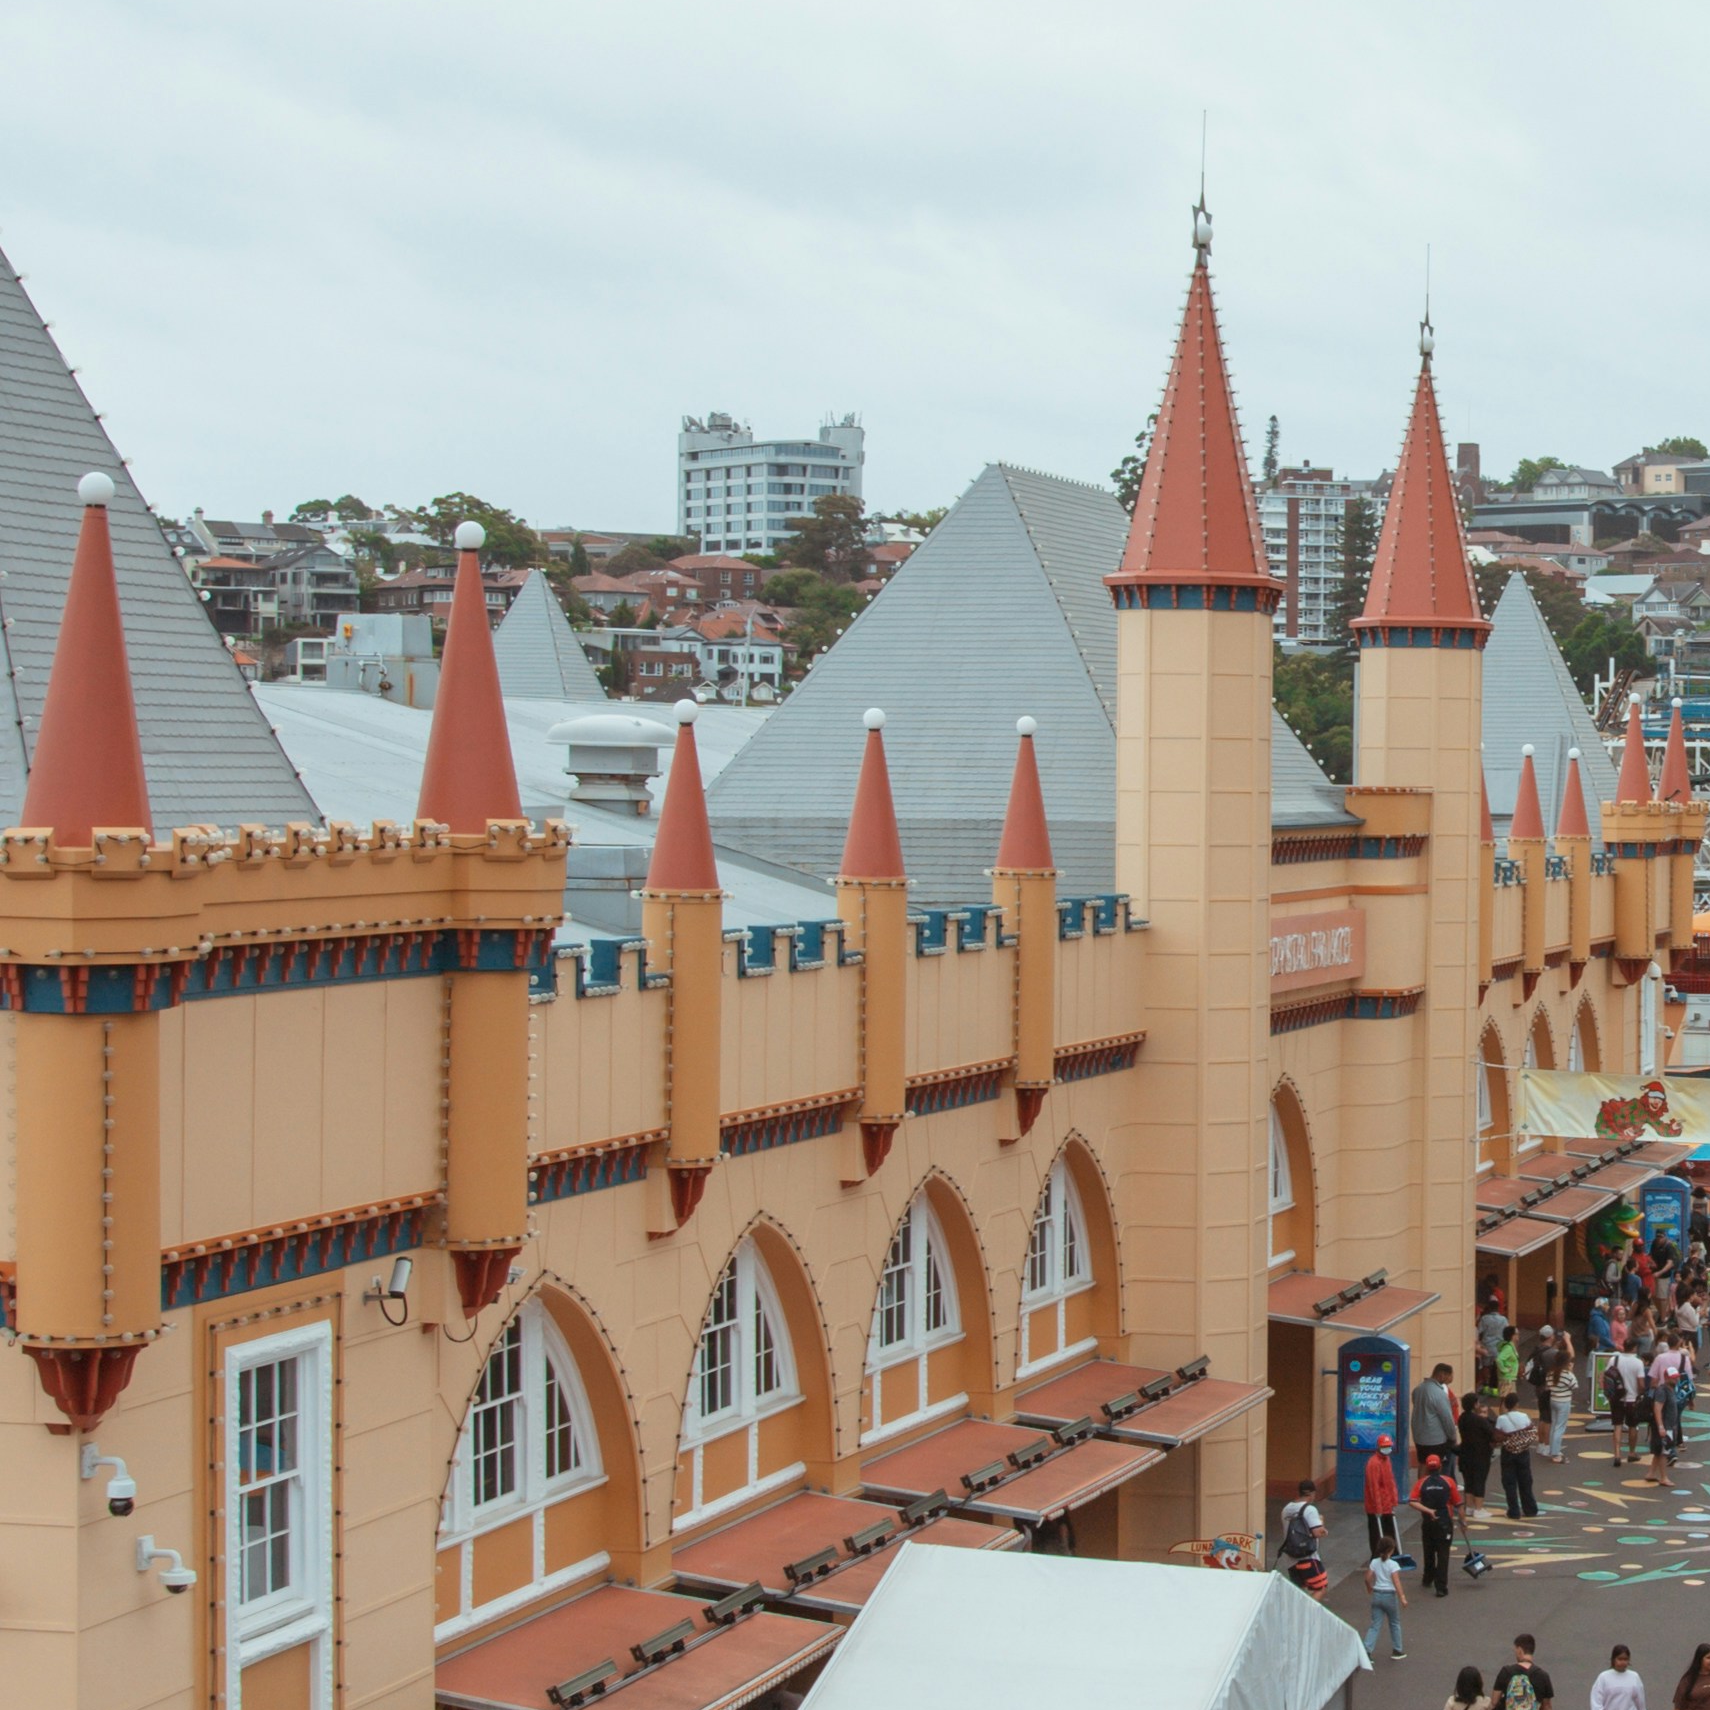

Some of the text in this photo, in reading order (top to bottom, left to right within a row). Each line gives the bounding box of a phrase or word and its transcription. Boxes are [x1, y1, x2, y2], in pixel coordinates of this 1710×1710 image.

[1359, 1376, 1383, 1384] GRAB
[1359, 1384, 1383, 1392] YOUR
[1352, 1392, 1391, 1400] TICKETS
[1226, 1536, 1253, 1550] PARK
